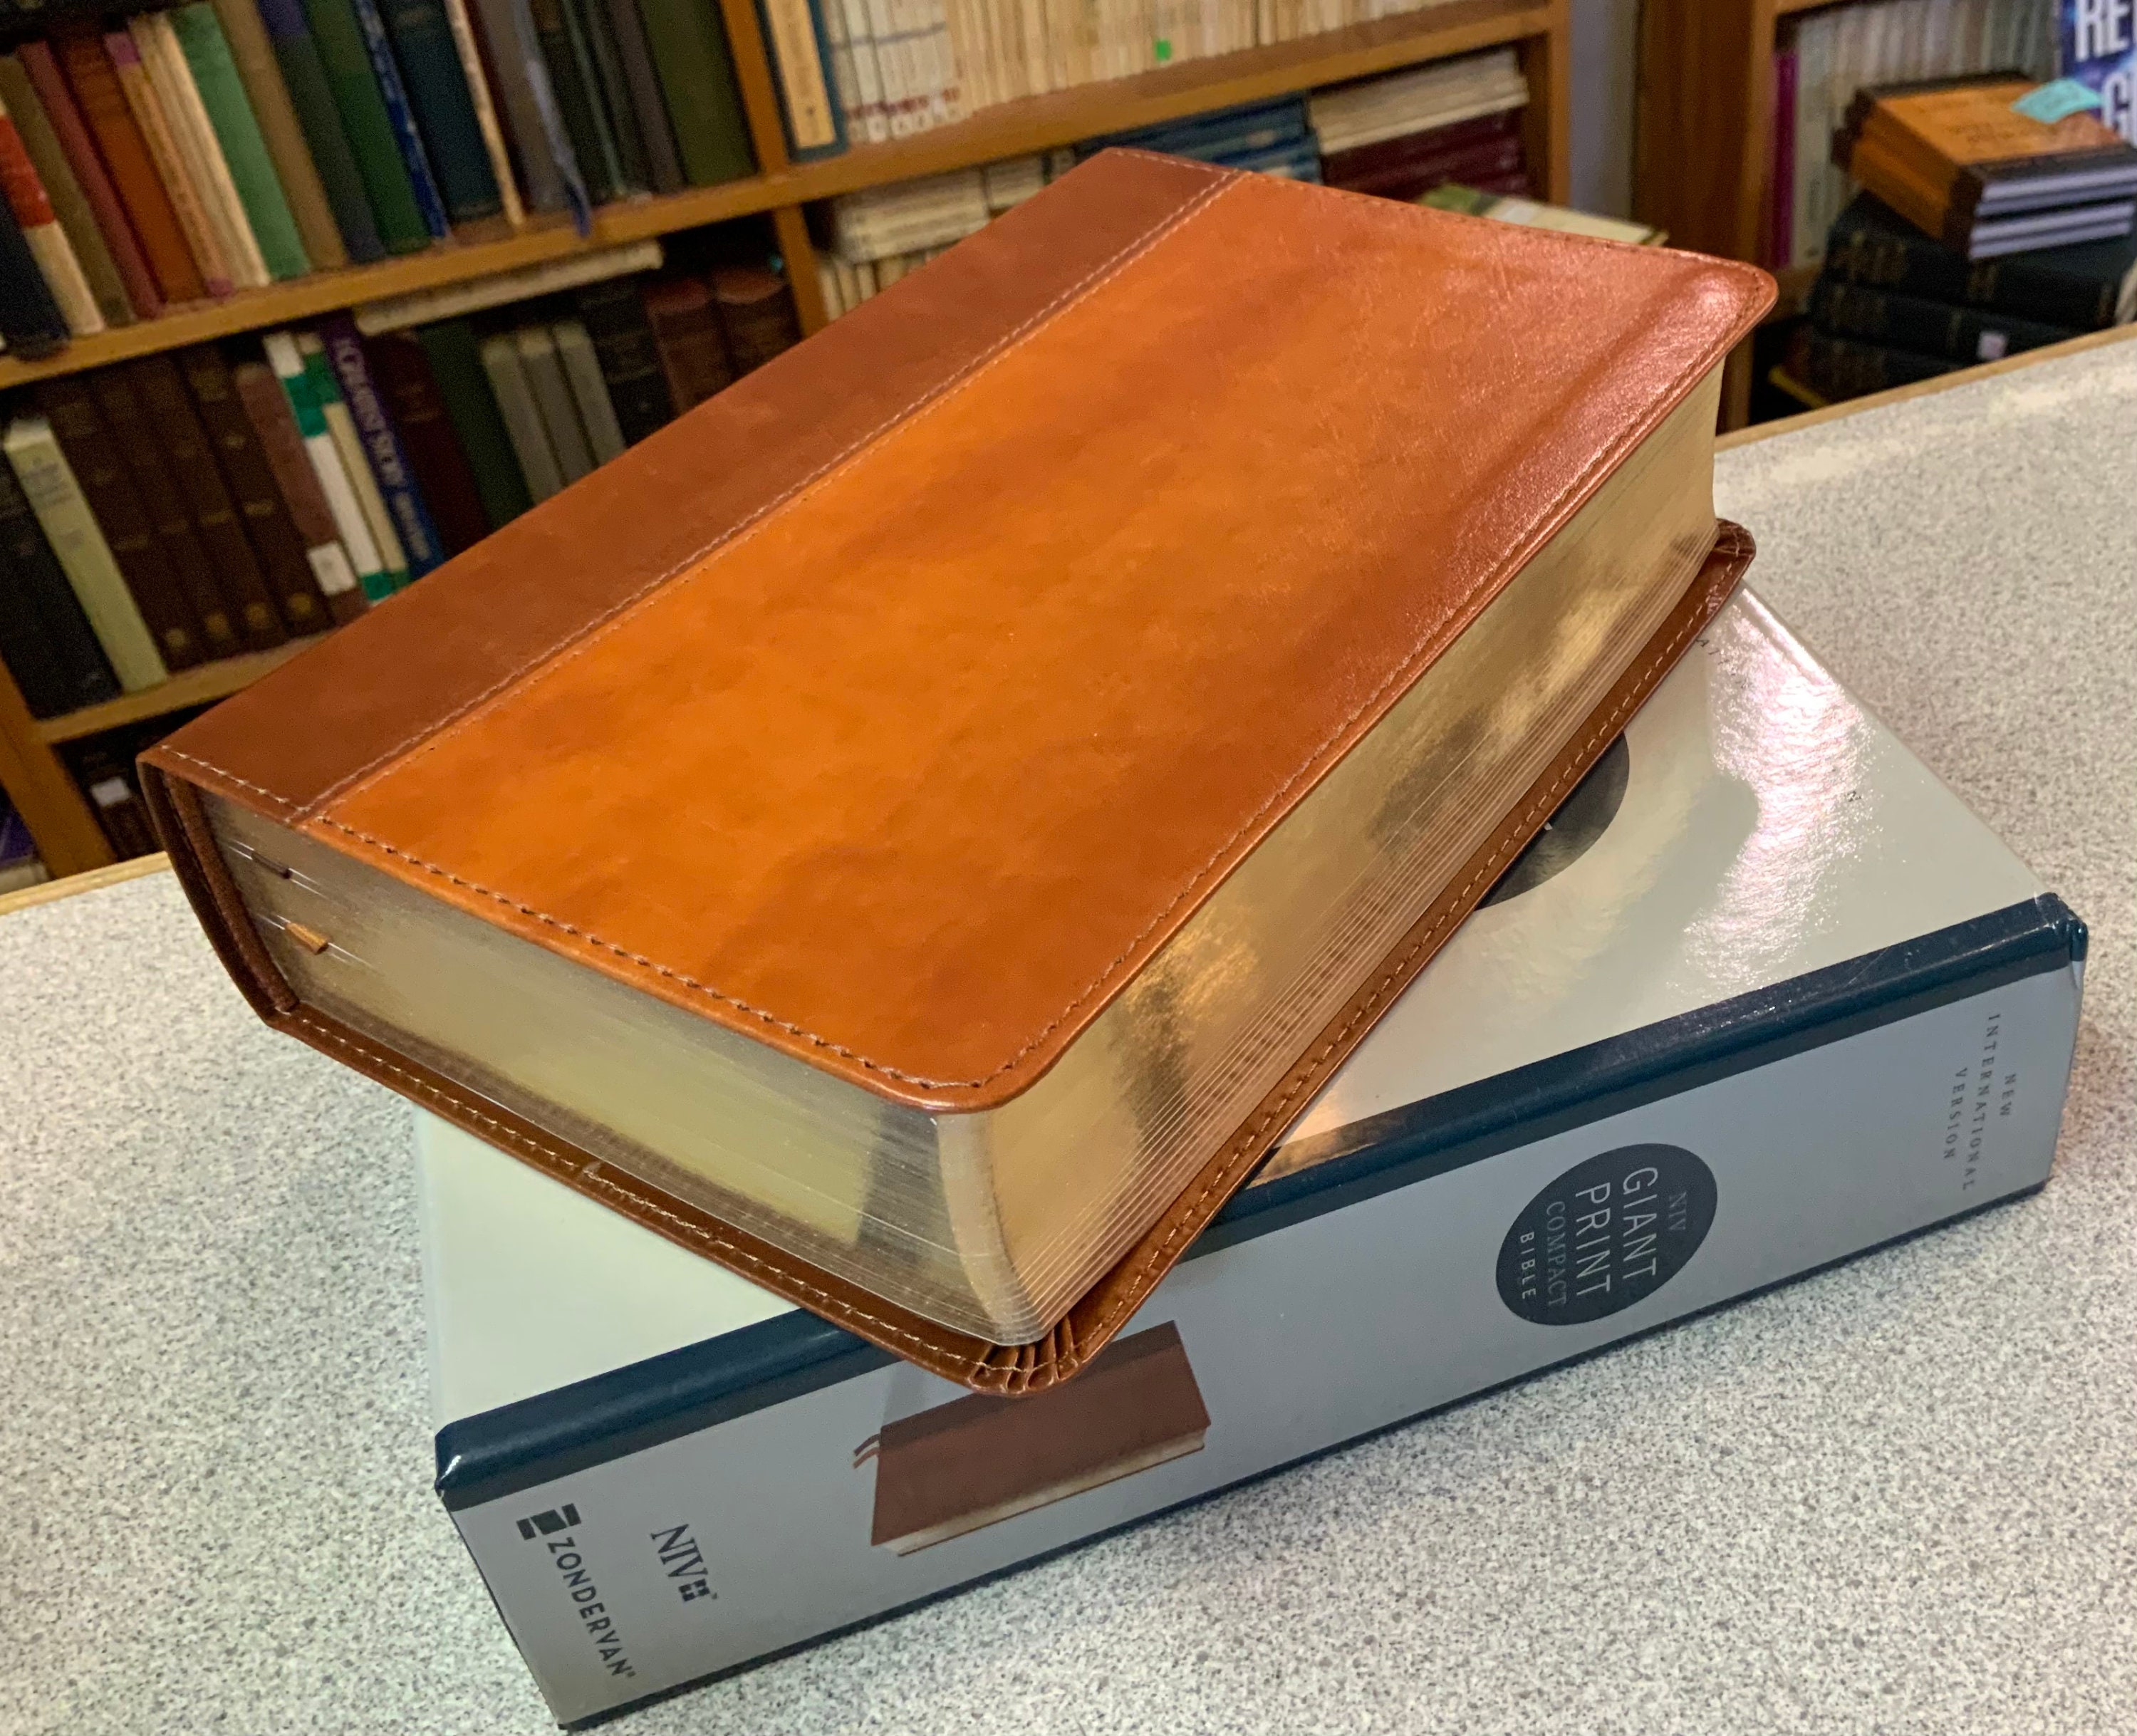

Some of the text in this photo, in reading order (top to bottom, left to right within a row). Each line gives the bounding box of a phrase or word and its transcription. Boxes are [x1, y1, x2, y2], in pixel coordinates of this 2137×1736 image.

[2075, 0, 2137, 62] RE
[1943, 1067, 1967, 1159] VERSION
[1962, 1014, 2001, 1190] INTERNATIONAL
[2000, 1073, 2017, 1116] NEW
[1575, 1183, 1611, 1296] PRINT
[1623, 1167, 1658, 1279] GIANT
[1668, 1191, 1688, 1231] NIV
[1520, 1232, 1536, 1299] BIBLE
[1546, 1201, 1567, 1307] COMPACT
[650, 1524, 709, 1577] NIV
